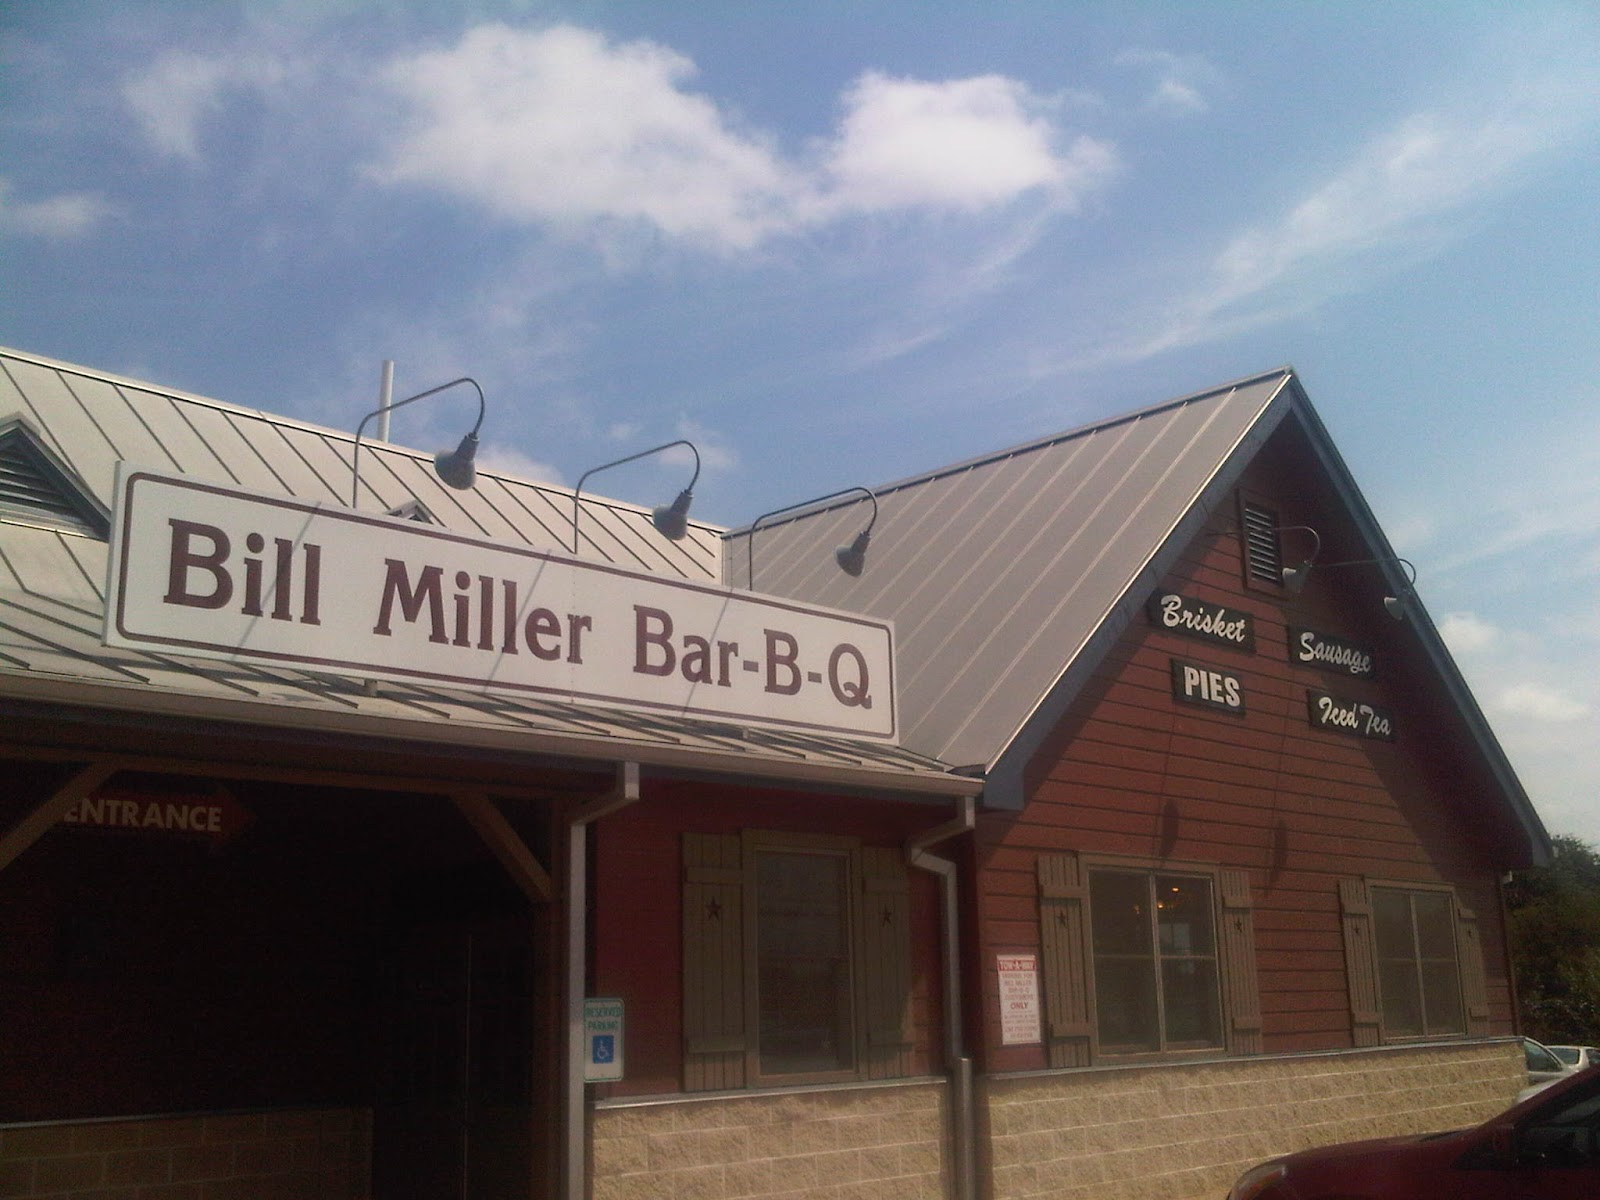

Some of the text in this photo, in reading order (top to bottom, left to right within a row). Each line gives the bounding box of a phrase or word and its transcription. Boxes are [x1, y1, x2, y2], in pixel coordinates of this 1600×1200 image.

[163, 517, 872, 710] Bill Miller Bar-B-Q
[1160, 594, 1246, 642] Brisket
[1299, 632, 1371, 674] Sausage
[1184, 666, 1241, 707] PIES
[1318, 696, 1391, 736] Iced Tea
